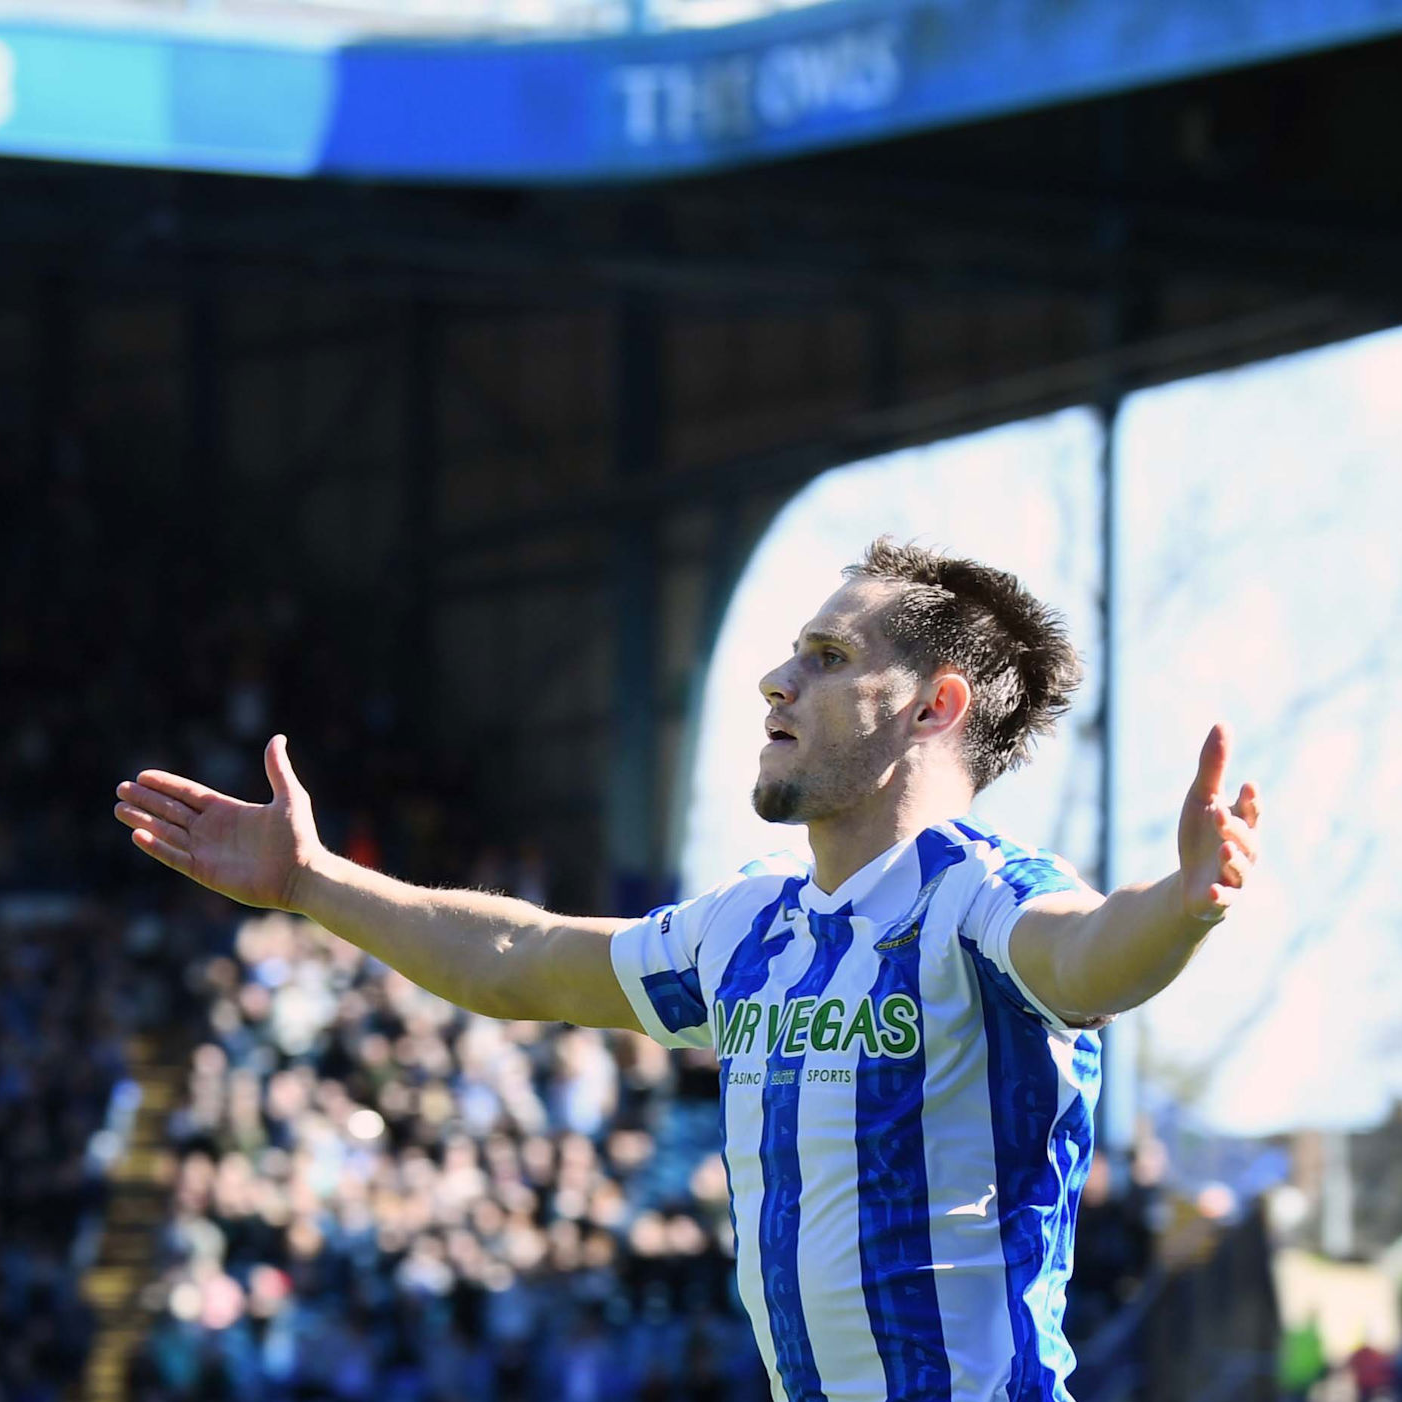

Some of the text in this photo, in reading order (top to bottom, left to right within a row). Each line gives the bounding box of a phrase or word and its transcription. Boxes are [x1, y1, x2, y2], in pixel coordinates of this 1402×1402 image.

[714, 994, 920, 1058] MR VEGAS
[728, 1071, 762, 1085] CASINO
[806, 1069, 852, 1083] SPORTS
